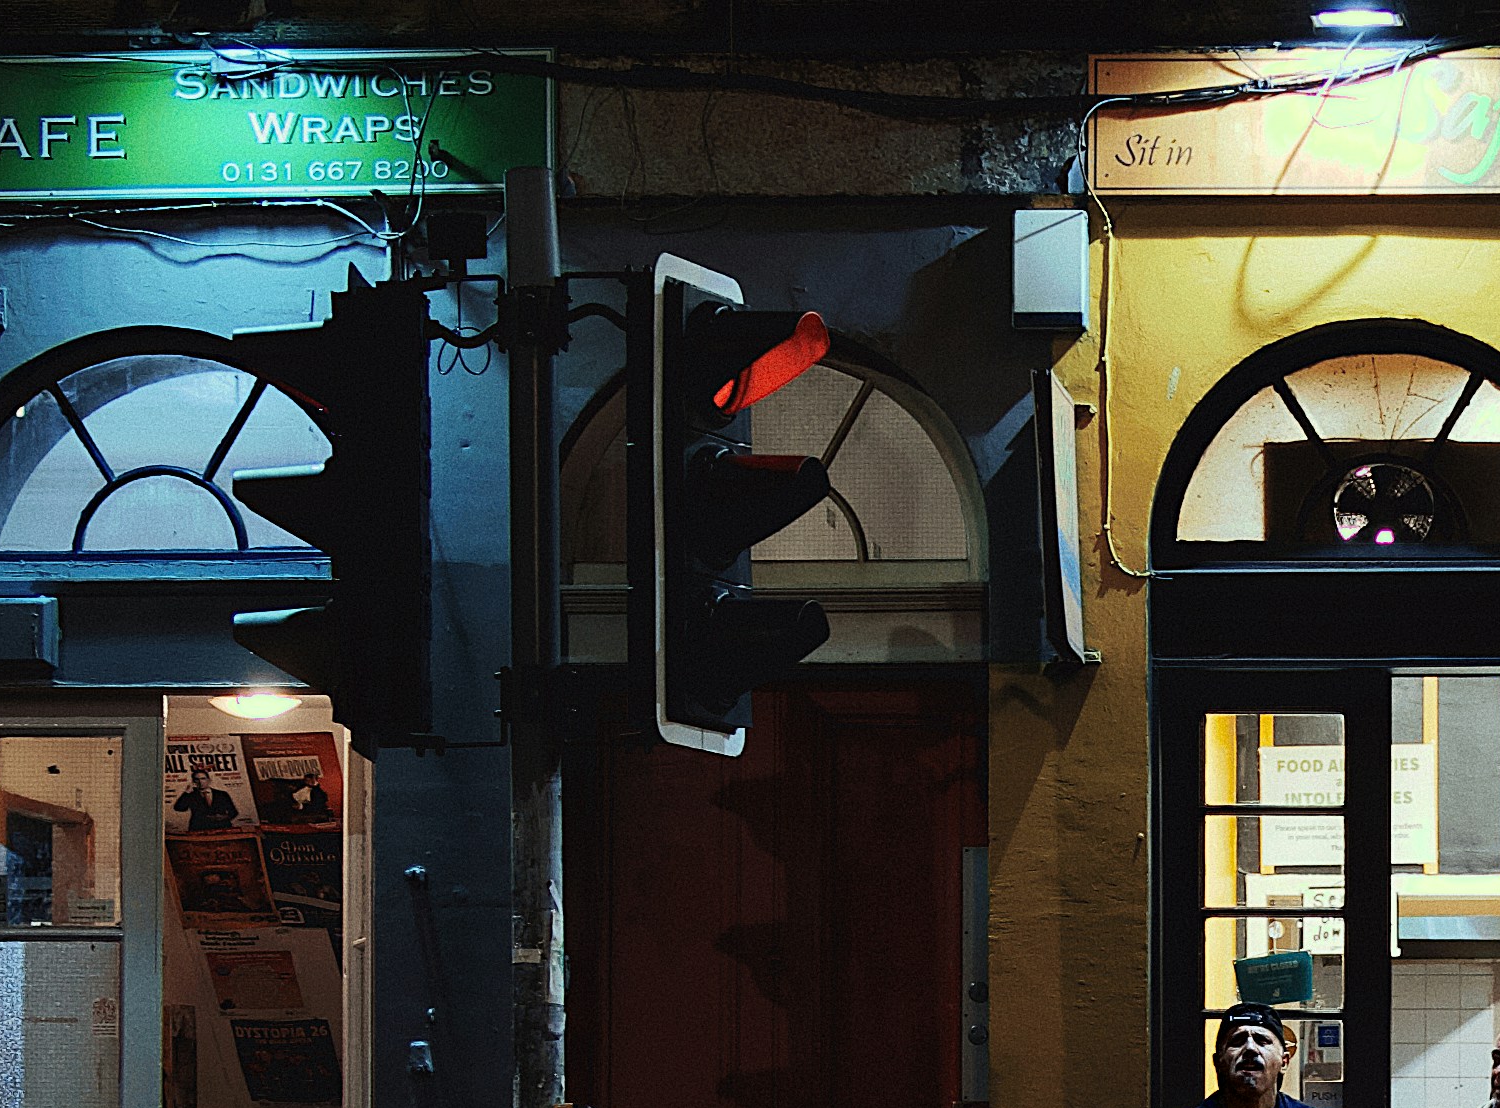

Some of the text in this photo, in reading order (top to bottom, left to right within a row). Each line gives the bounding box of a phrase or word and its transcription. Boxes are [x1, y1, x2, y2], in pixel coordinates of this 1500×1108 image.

[173, 68, 494, 101] SANDWICHES
[249, 109, 422, 146] WRAPS
[1115, 134, 1194, 168] Sit in
[221, 159, 295, 184] 0131
[305, 159, 365, 184] 667
[164, 753, 188, 773] ALL
[1276, 758, 1324, 773] FOOD
[233, 1025, 306, 1039] DYSTOPIA
